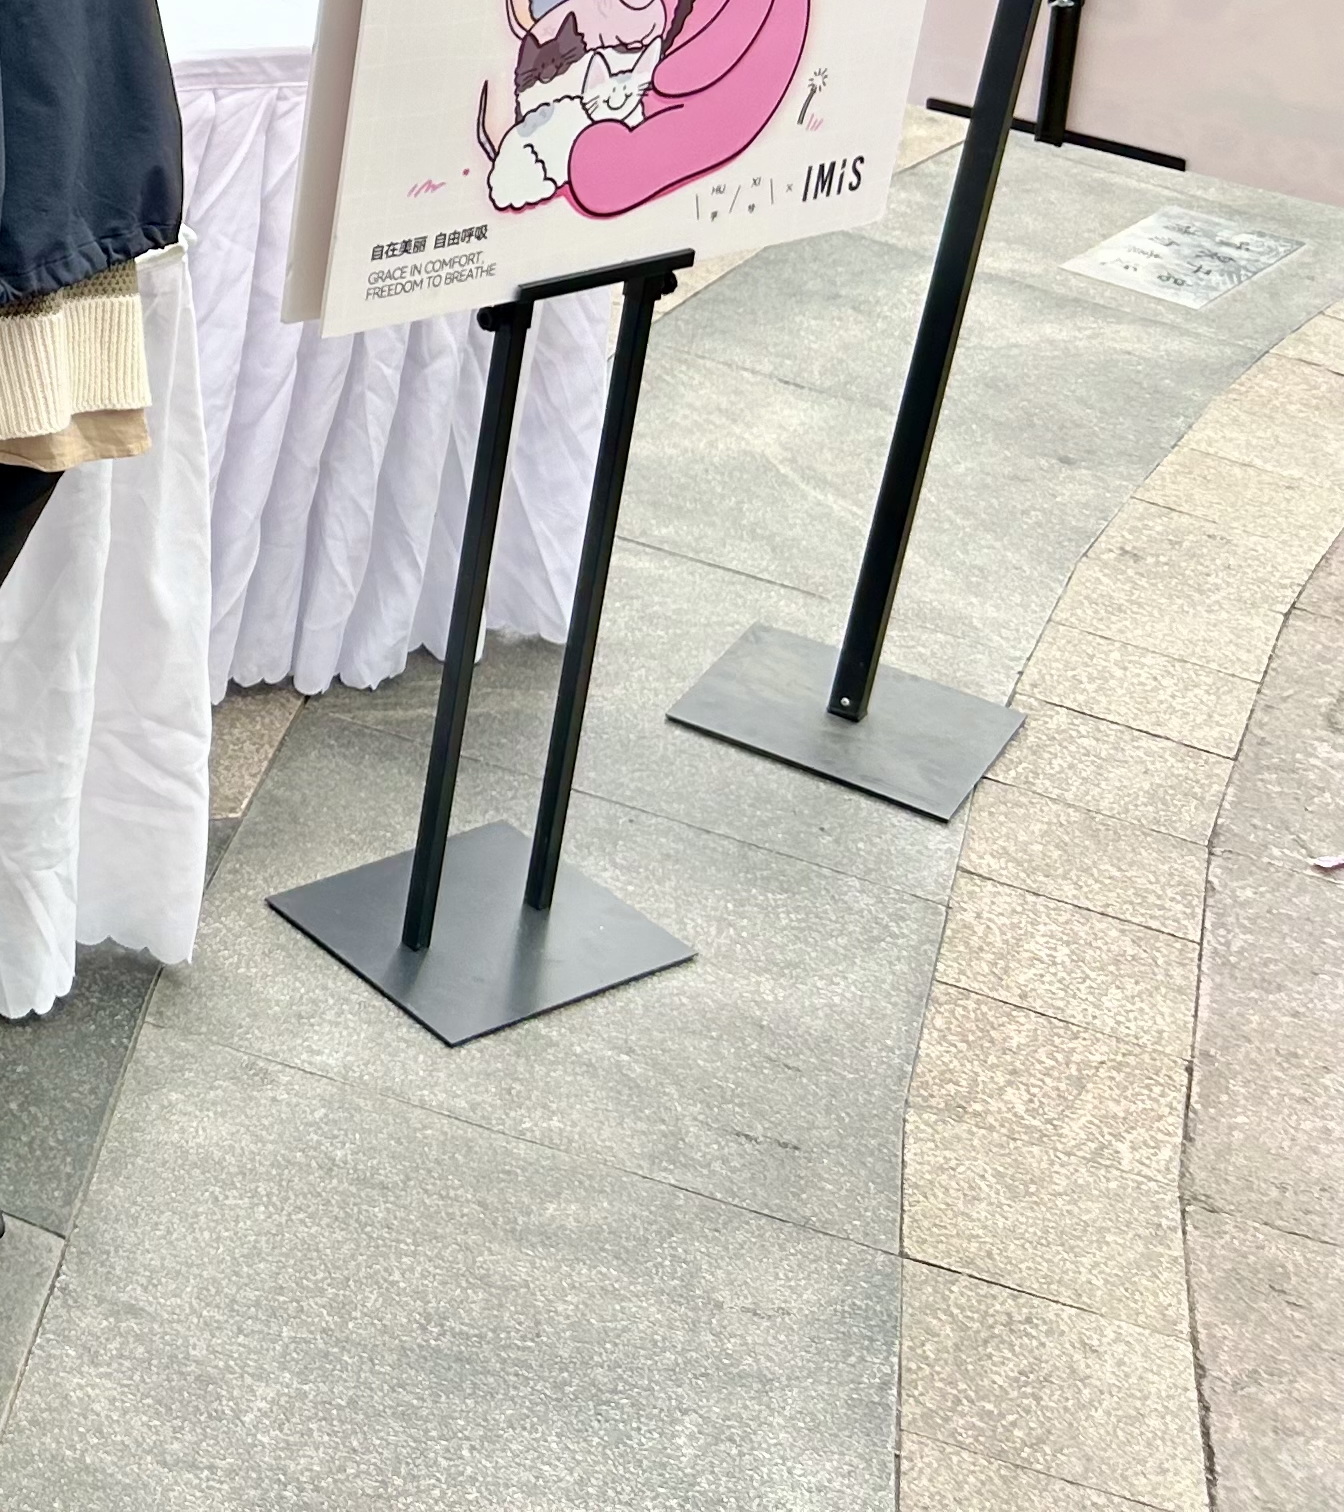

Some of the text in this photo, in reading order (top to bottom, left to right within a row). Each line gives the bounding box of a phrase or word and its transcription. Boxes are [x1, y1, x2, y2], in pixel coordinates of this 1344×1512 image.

[370, 224, 488, 262] 自在美丽 自由呼吸
[365, 262, 497, 302] FREEDOM TO BREATHE
[367, 265, 408, 286] GRACE
[409, 263, 423, 278] IN
